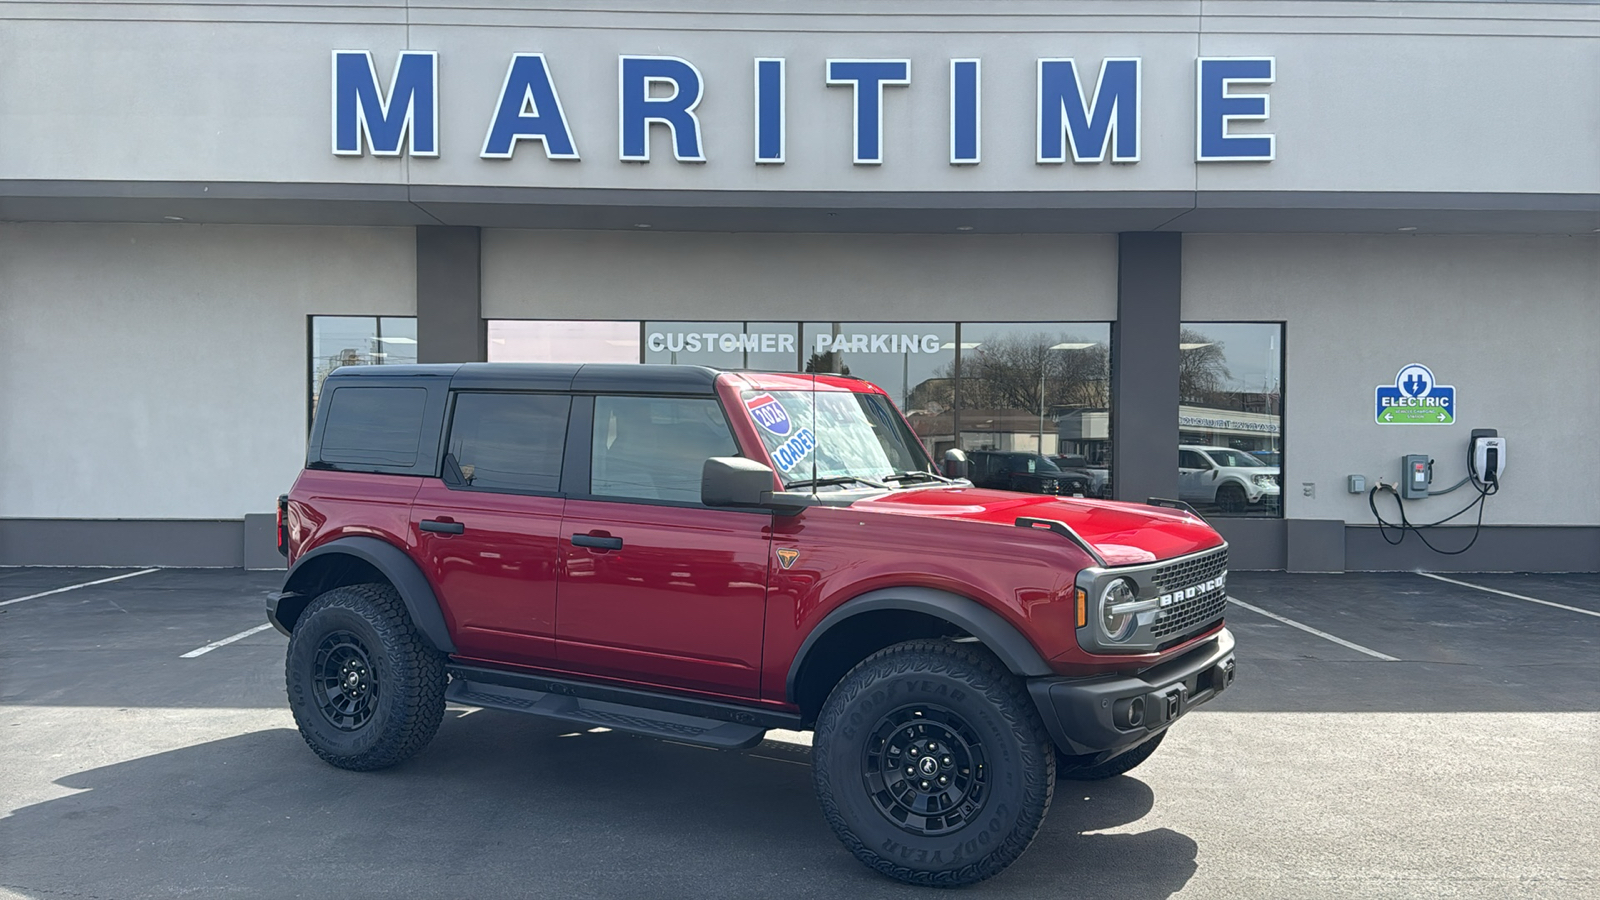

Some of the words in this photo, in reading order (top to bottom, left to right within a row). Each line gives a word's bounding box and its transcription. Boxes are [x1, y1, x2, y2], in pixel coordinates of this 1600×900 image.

[331, 49, 1276, 164] MARITIME
[647, 332, 795, 353] CUSTOMER
[816, 333, 941, 354] PARKING
[755, 403, 787, 427] 2026
[1381, 396, 1449, 407] ELECTRIC
[773, 429, 815, 471] LOADED
[1160, 576, 1223, 607] BRONCO
